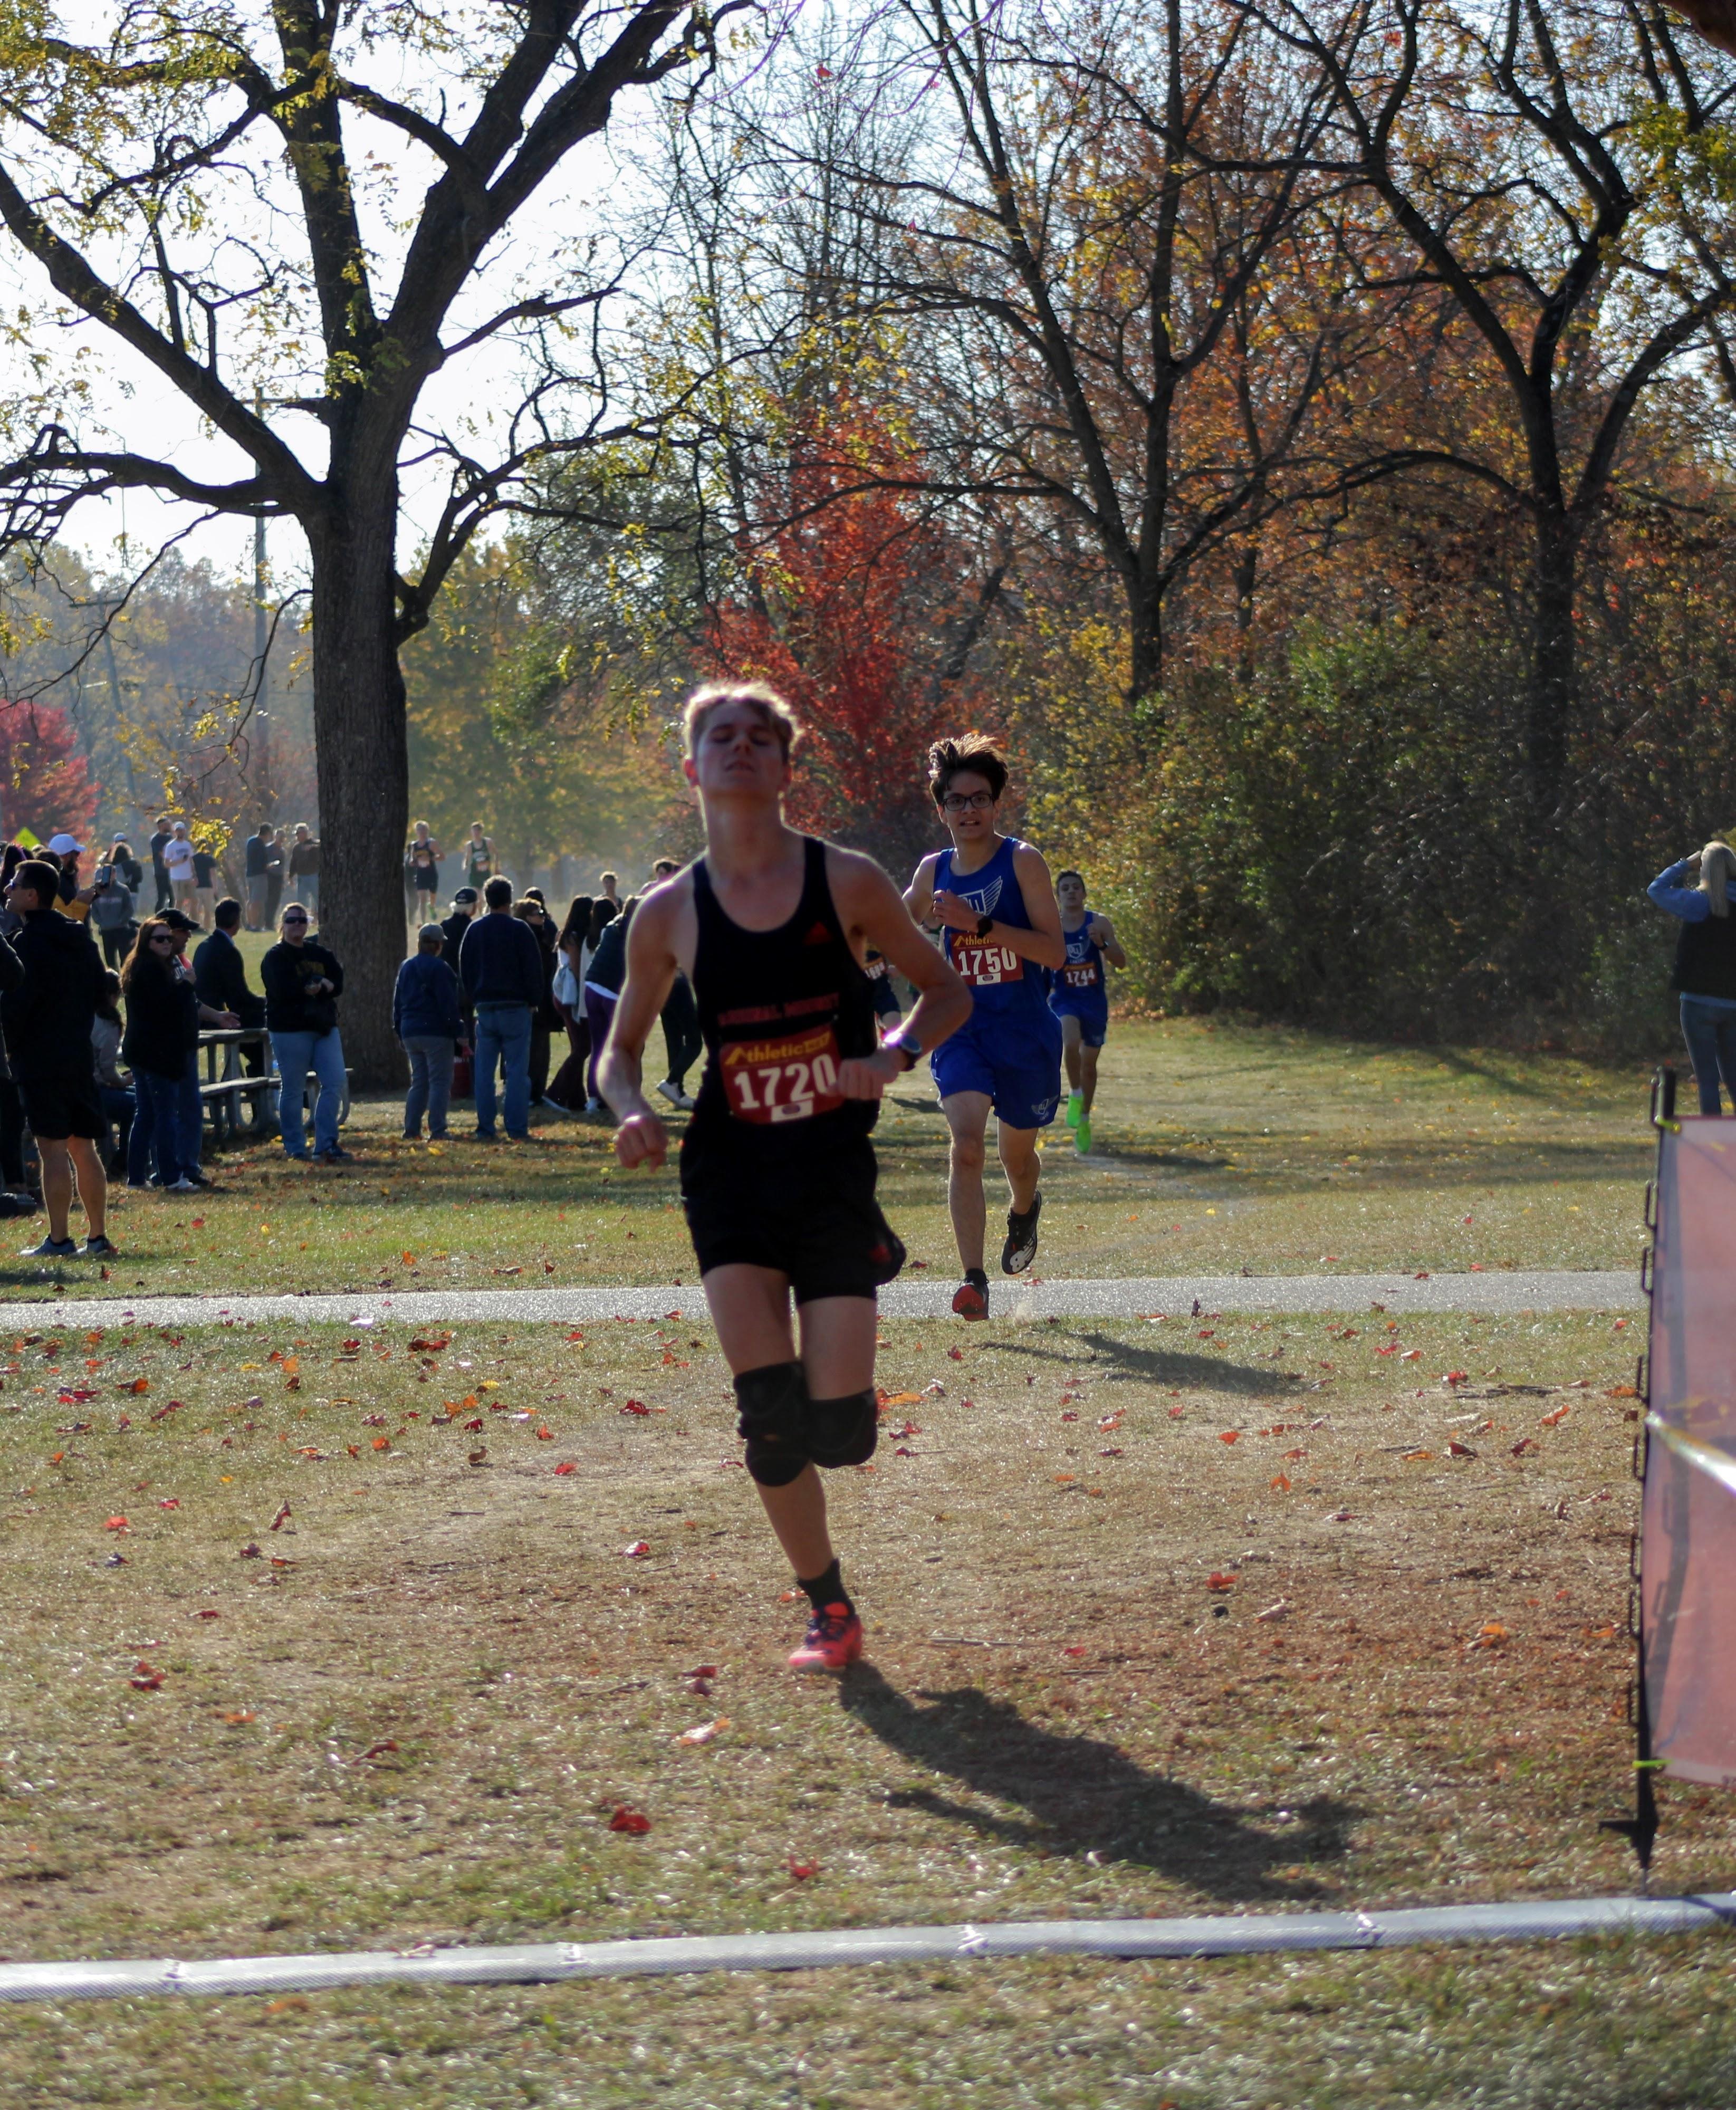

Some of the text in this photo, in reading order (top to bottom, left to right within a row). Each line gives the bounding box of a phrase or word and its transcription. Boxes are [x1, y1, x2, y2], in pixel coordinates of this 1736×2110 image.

[958, 947, 1018, 976] 1750
[1066, 968, 1095, 983] 1744
[734, 1053, 838, 1109] 1720
